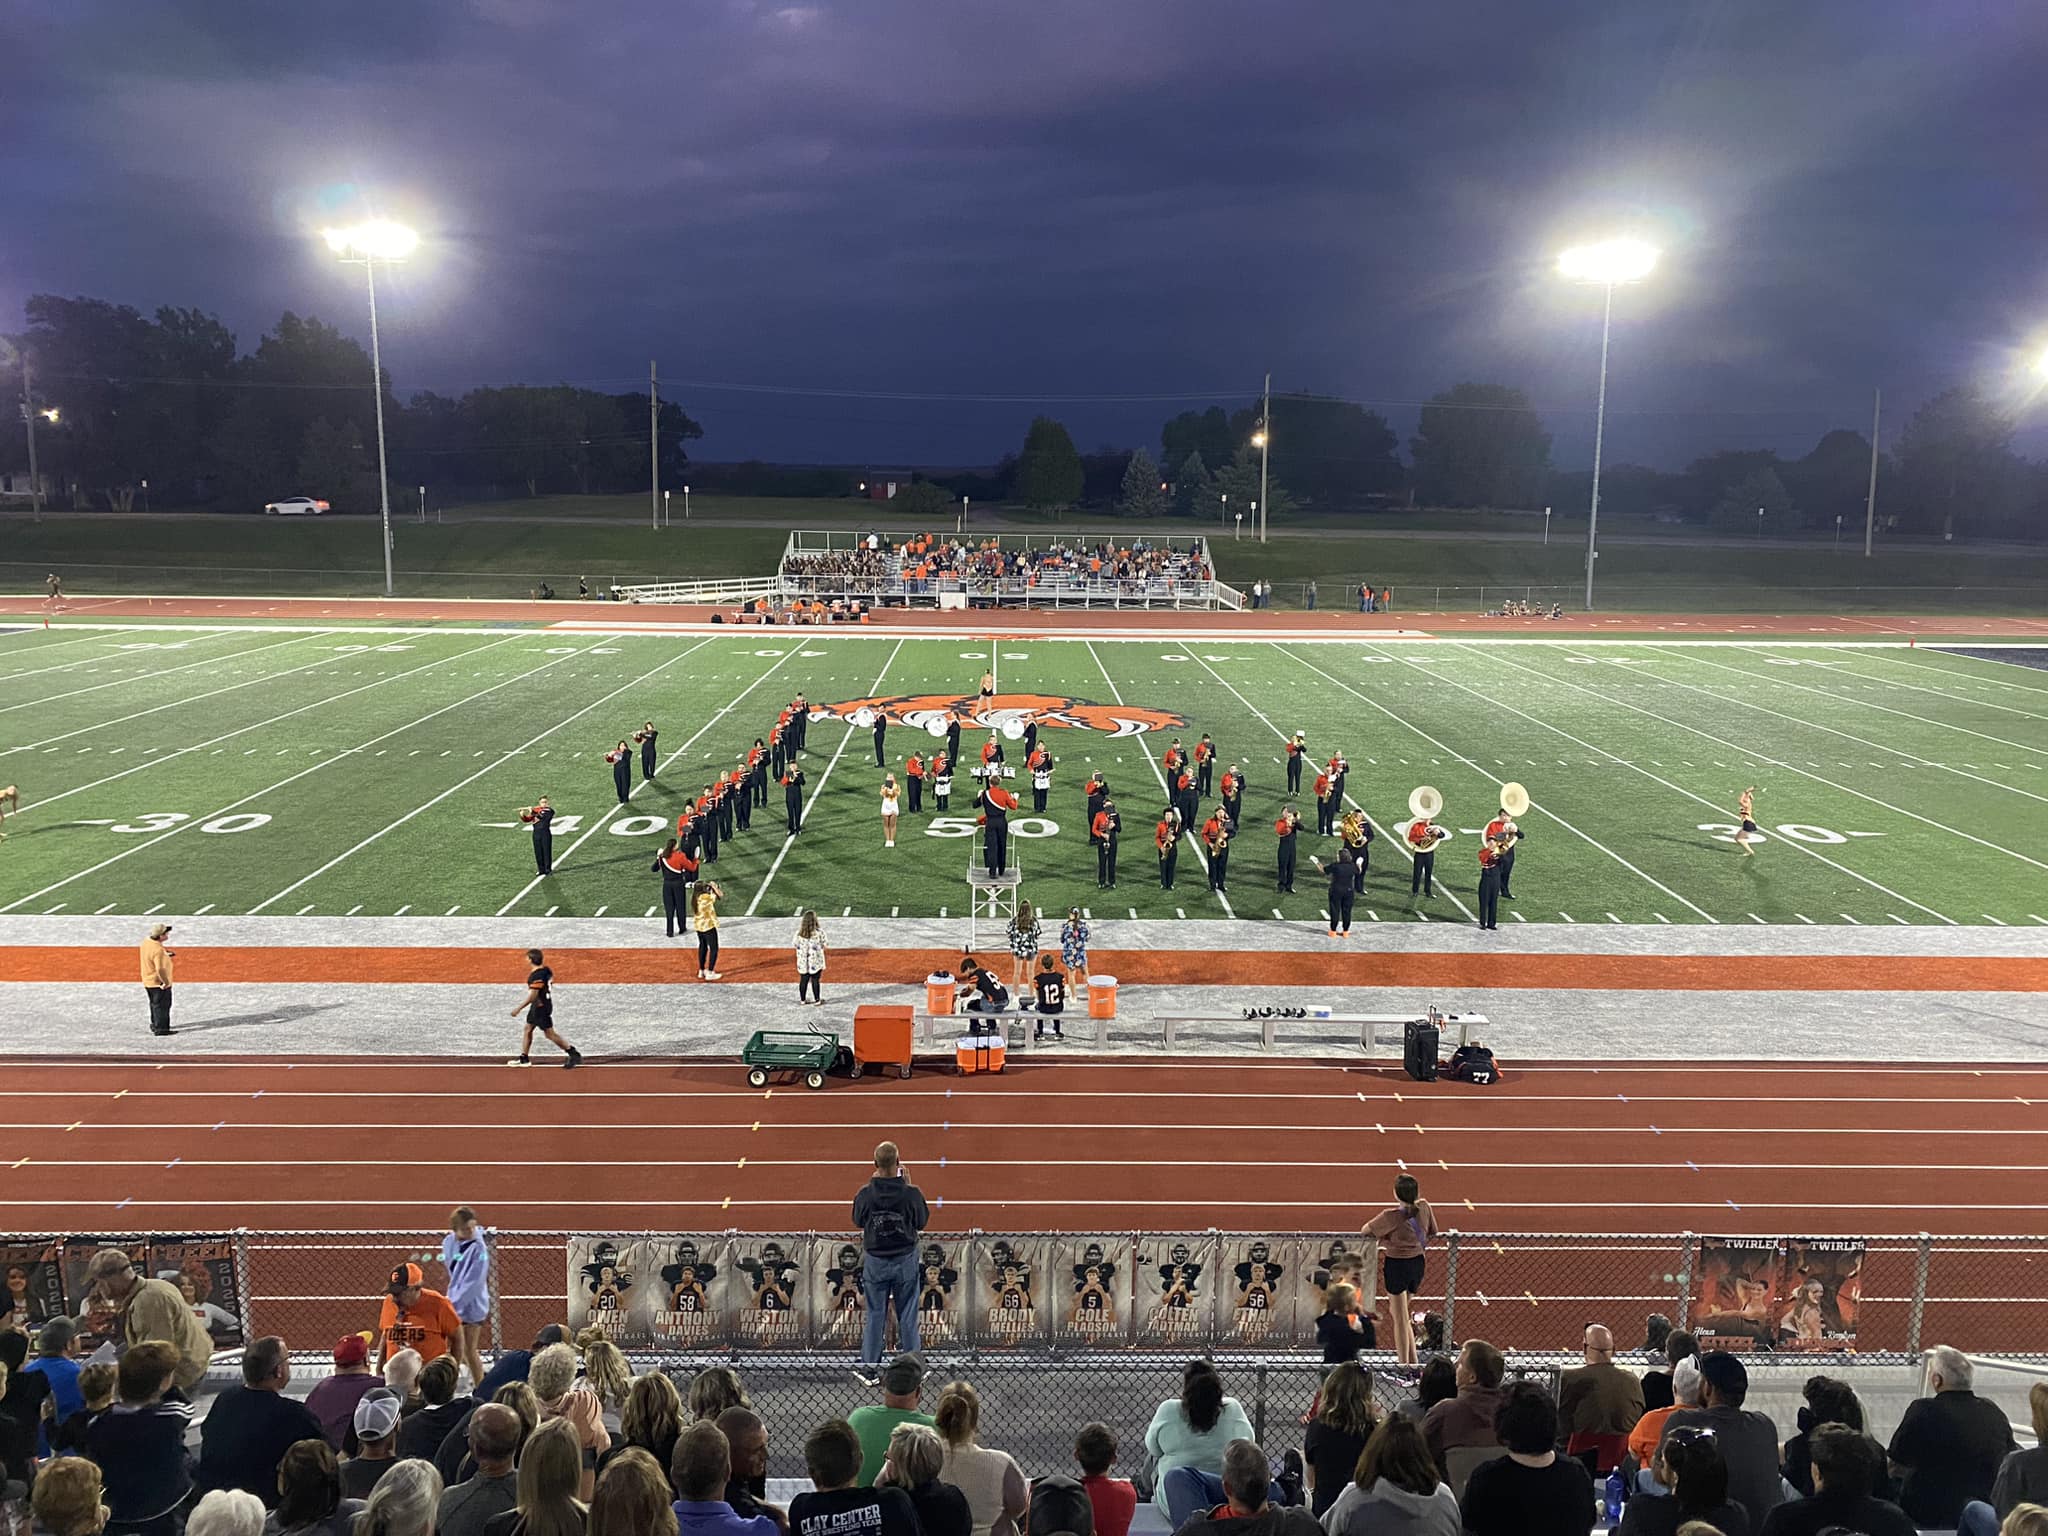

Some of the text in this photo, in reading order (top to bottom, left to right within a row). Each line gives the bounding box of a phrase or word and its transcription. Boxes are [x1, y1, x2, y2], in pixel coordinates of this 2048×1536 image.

[110, 813, 272, 833] 30
[923, 817, 1060, 838] 50
[1697, 823, 1848, 843] 30
[985, 970, 1003, 990] 5
[1043, 983, 1060, 1005] 12
[1725, 1239, 1779, 1249] TWIRLER
[1811, 1241, 1865, 1251] TWIRLER
[218, 1263, 236, 1312] 2025
[600, 1295, 616, 1310] 20
[679, 1295, 695, 1311] 58
[766, 1293, 774, 1308] 6
[1004, 1294, 1018, 1308] 66
[1088, 1296, 1096, 1308] 5
[1173, 1294, 1180, 1306] 7
[1249, 1293, 1265, 1308] 56
[586, 1309, 629, 1323] OWEN
[655, 1311, 720, 1325] ANTHONY
[739, 1309, 799, 1324] WESTON
[821, 1310, 867, 1324] WALKE
[917, 1310, 958, 1324] ALTON
[989, 1308, 1037, 1322] BRODY
[1075, 1308, 1110, 1322] COLE
[1149, 1307, 1199, 1322] COLTEN
[1233, 1308, 1277, 1322] ETHAN
[668, 1325, 710, 1336] DAVIES
[741, 1322, 799, 1334] HAMMOND
[918, 1323, 956, 1335] CCANN
[991, 1322, 1035, 1333] MELLIES
[1067, 1322, 1118, 1332] PLADSON
[1238, 1322, 1270, 1333] TIERS
[800, 1504, 881, 1535] CLAY CENTER
[862, 1518, 882, 1528] TEAM
